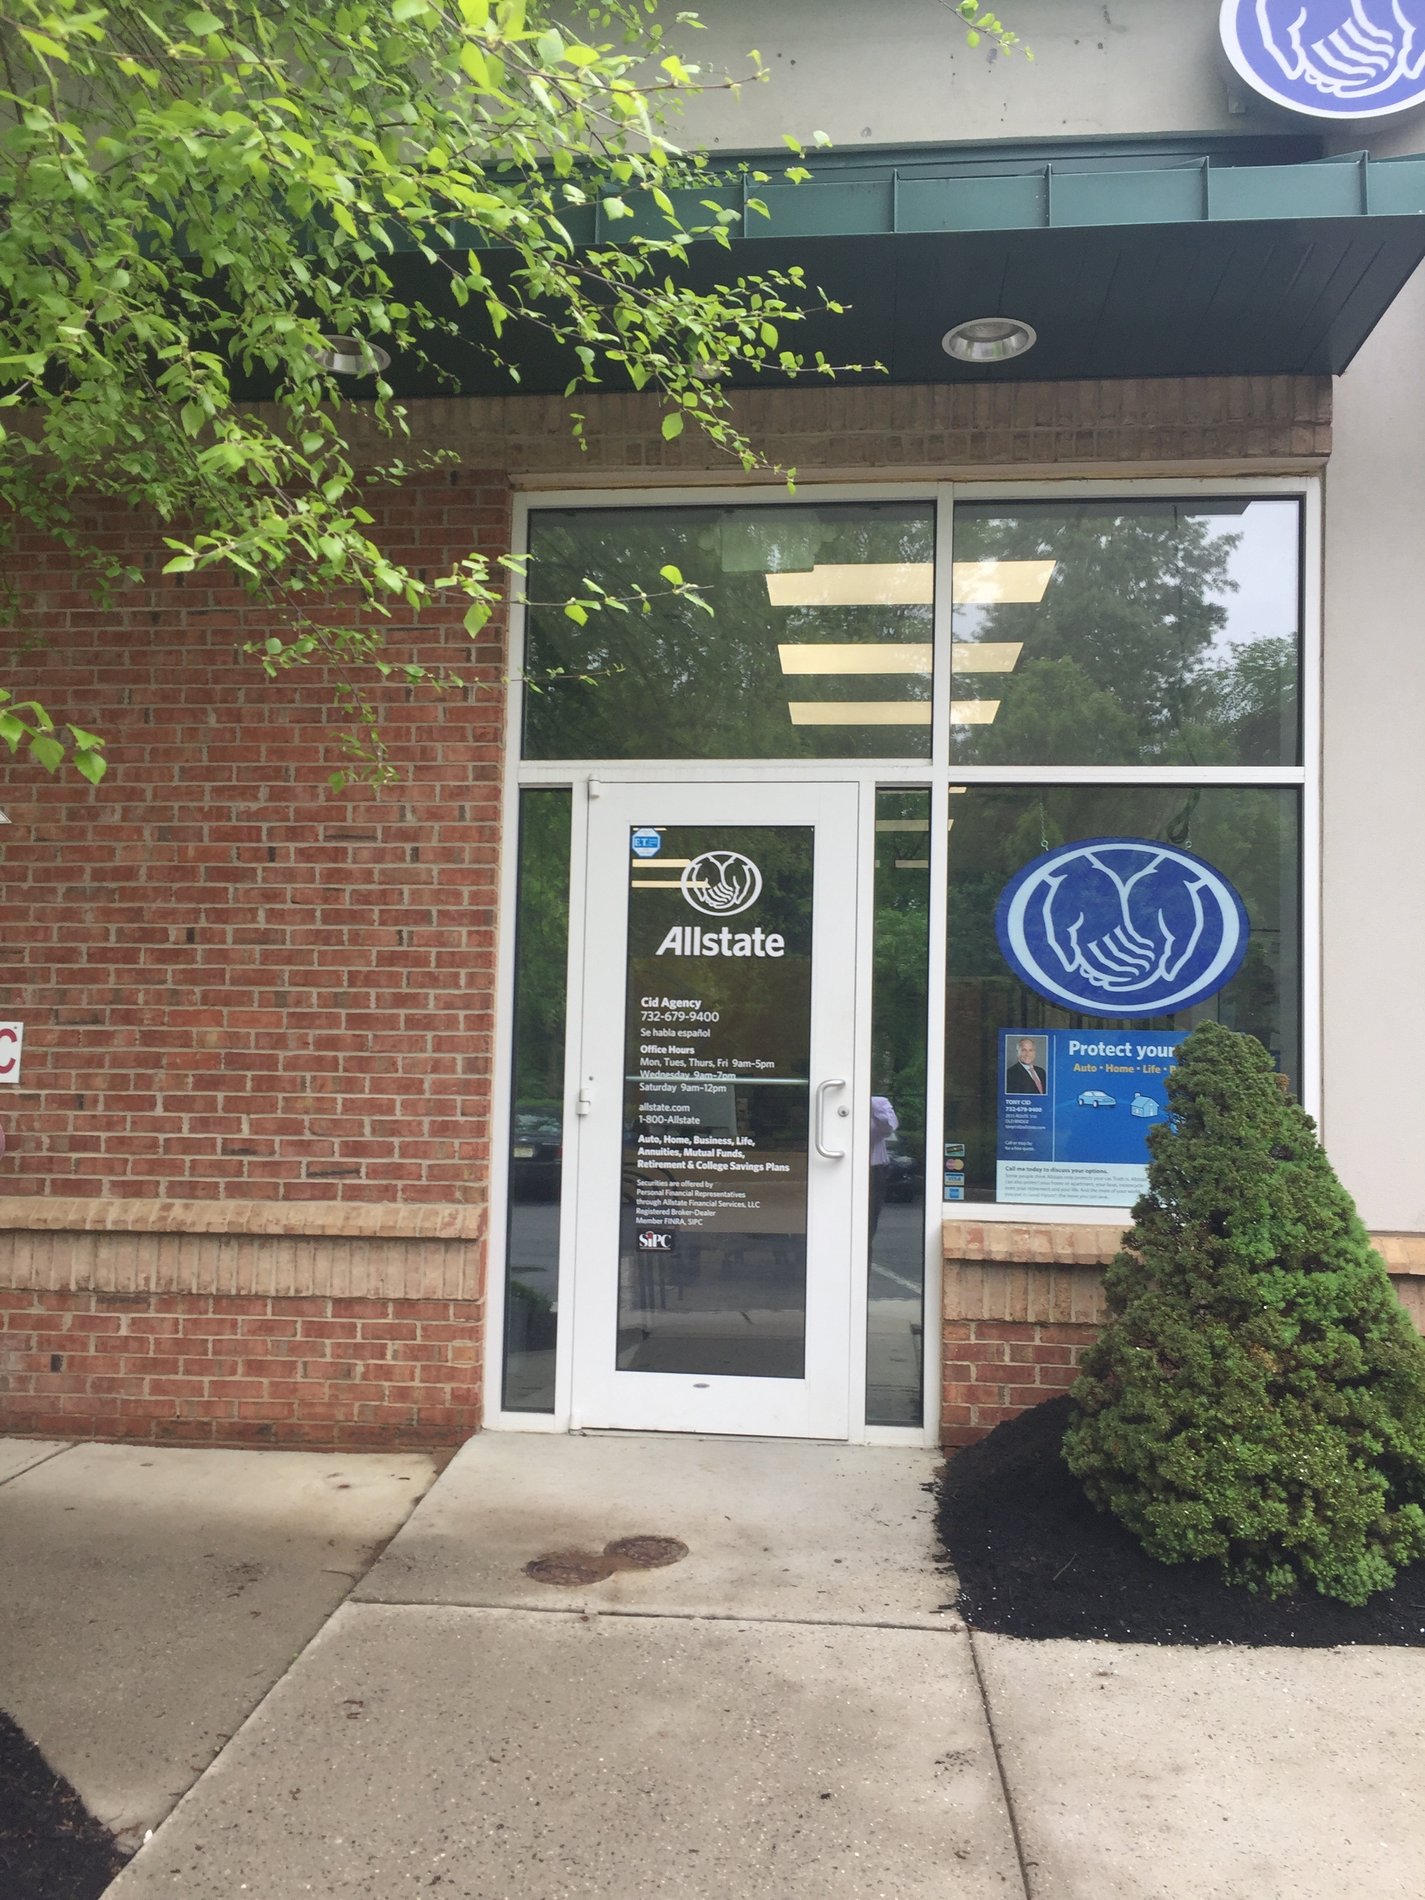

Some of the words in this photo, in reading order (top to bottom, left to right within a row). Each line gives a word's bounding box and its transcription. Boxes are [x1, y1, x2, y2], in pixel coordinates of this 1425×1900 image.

[655, 926, 785, 957] Allstate
[641, 997, 659, 1008] Cid
[661, 997, 702, 1010] Agency
[641, 1011, 720, 1023] 732-679-9400
[640, 1028, 651, 1037] Se
[652, 1028, 676, 1037] habla
[677, 1028, 711, 1039] español
[640, 1044, 667, 1054] Office
[668, 1045, 695, 1054] Hours
[1069, 1040, 1132, 1056] Protect
[1136, 1045, 1175, 1060] your
[640, 1058, 662, 1067] Mon,
[664, 1058, 687, 1068] Tues,
[688, 1058, 715, 1068] Thurs,
[717, 1059, 729, 1068] Fri
[732, 1059, 775, 1070] 9am-5pm
[1073, 1063, 1097, 1072] Auto
[1105, 1064, 1135, 1073] Home
[1143, 1064, 1161, 1074] Life
[640, 1070, 690, 1080] Wednesday
[693, 1071, 736, 1081] 9am-7pm
[639, 1082, 677, 1093] Saturday
[680, 1083, 727, 1094] 9am-12pm
[638, 1103, 690, 1112] allstate.com
[638, 1115, 700, 1125] 1-800-Allstate
[638, 1135, 662, 1144] Auto,
[663, 1135, 692, 1145] Home,
[693, 1136, 735, 1146] Business,
[736, 1136, 756, 1147] Life,
[637, 1147, 682, 1157] Annuities,
[683, 1147, 715, 1158] Mutual
[716, 1149, 745, 1159] Funds,
[637, 1160, 686, 1169] Retirement
[686, 1160, 695, 1169] &
[695, 1160, 729, 1172] College
[730, 1162, 764, 1173] Savings
[766, 1162, 790, 1172] Plans
[636, 1179, 668, 1187] Securities
[680, 1180, 704, 1188] offered
[704, 1181, 714, 1189] by
[636, 1189, 664, 1197] Personal
[694, 1190, 746, 1199] Representatives
[636, 1199, 662, 1207] through
[662, 1199, 688, 1207] Allstate
[688, 1199, 717, 1207] Financial
[718, 1200, 747, 1209] Services,
[636, 1208, 670, 1216] Registered
[671, 1208, 716, 1217] Broker-Dealer
[636, 1217, 663, 1225] Member
